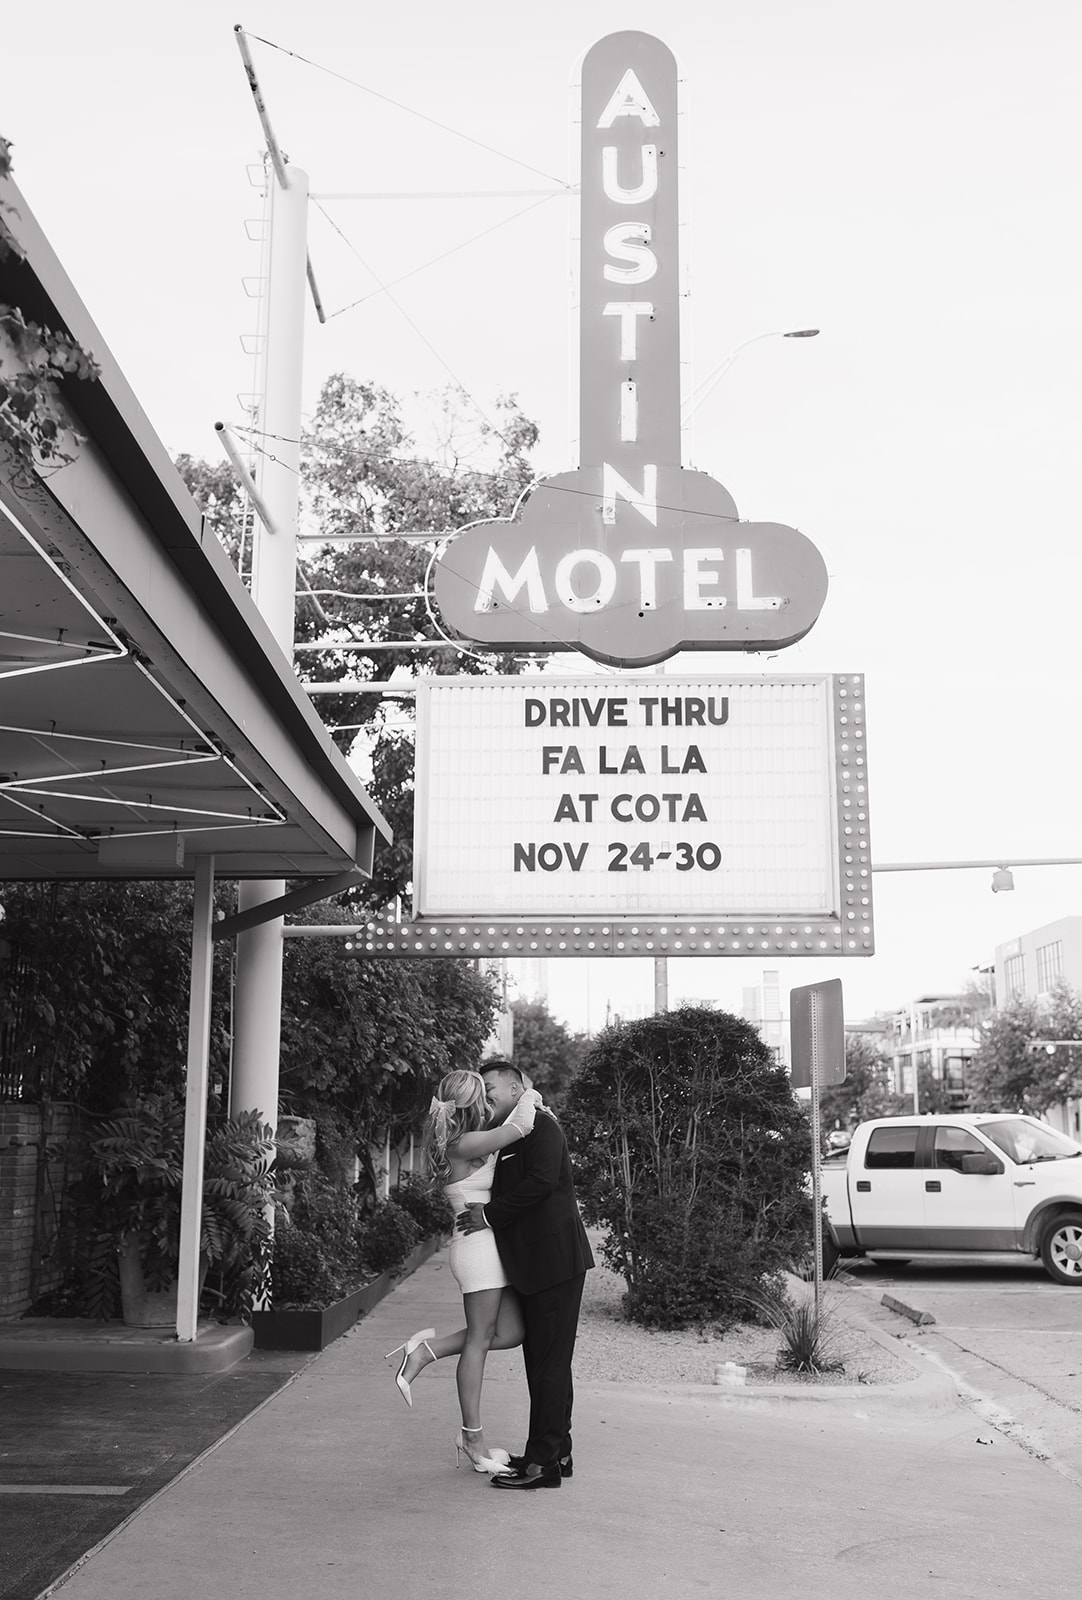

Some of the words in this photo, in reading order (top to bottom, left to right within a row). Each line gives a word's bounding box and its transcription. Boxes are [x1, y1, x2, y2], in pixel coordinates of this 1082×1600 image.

[596, 68, 661, 527] AUSTIN
[474, 545, 783, 613] MOTEL
[525, 698, 628, 727] DRIVE
[639, 697, 729, 726] THRU
[542, 745, 586, 775] FA
[599, 745, 646, 775] LA
[661, 745, 708, 775] LA
[553, 793, 599, 823] AT
[610, 793, 708, 823] COTA
[513, 842, 590, 872] NOV
[607, 842, 722, 872] 24-30
